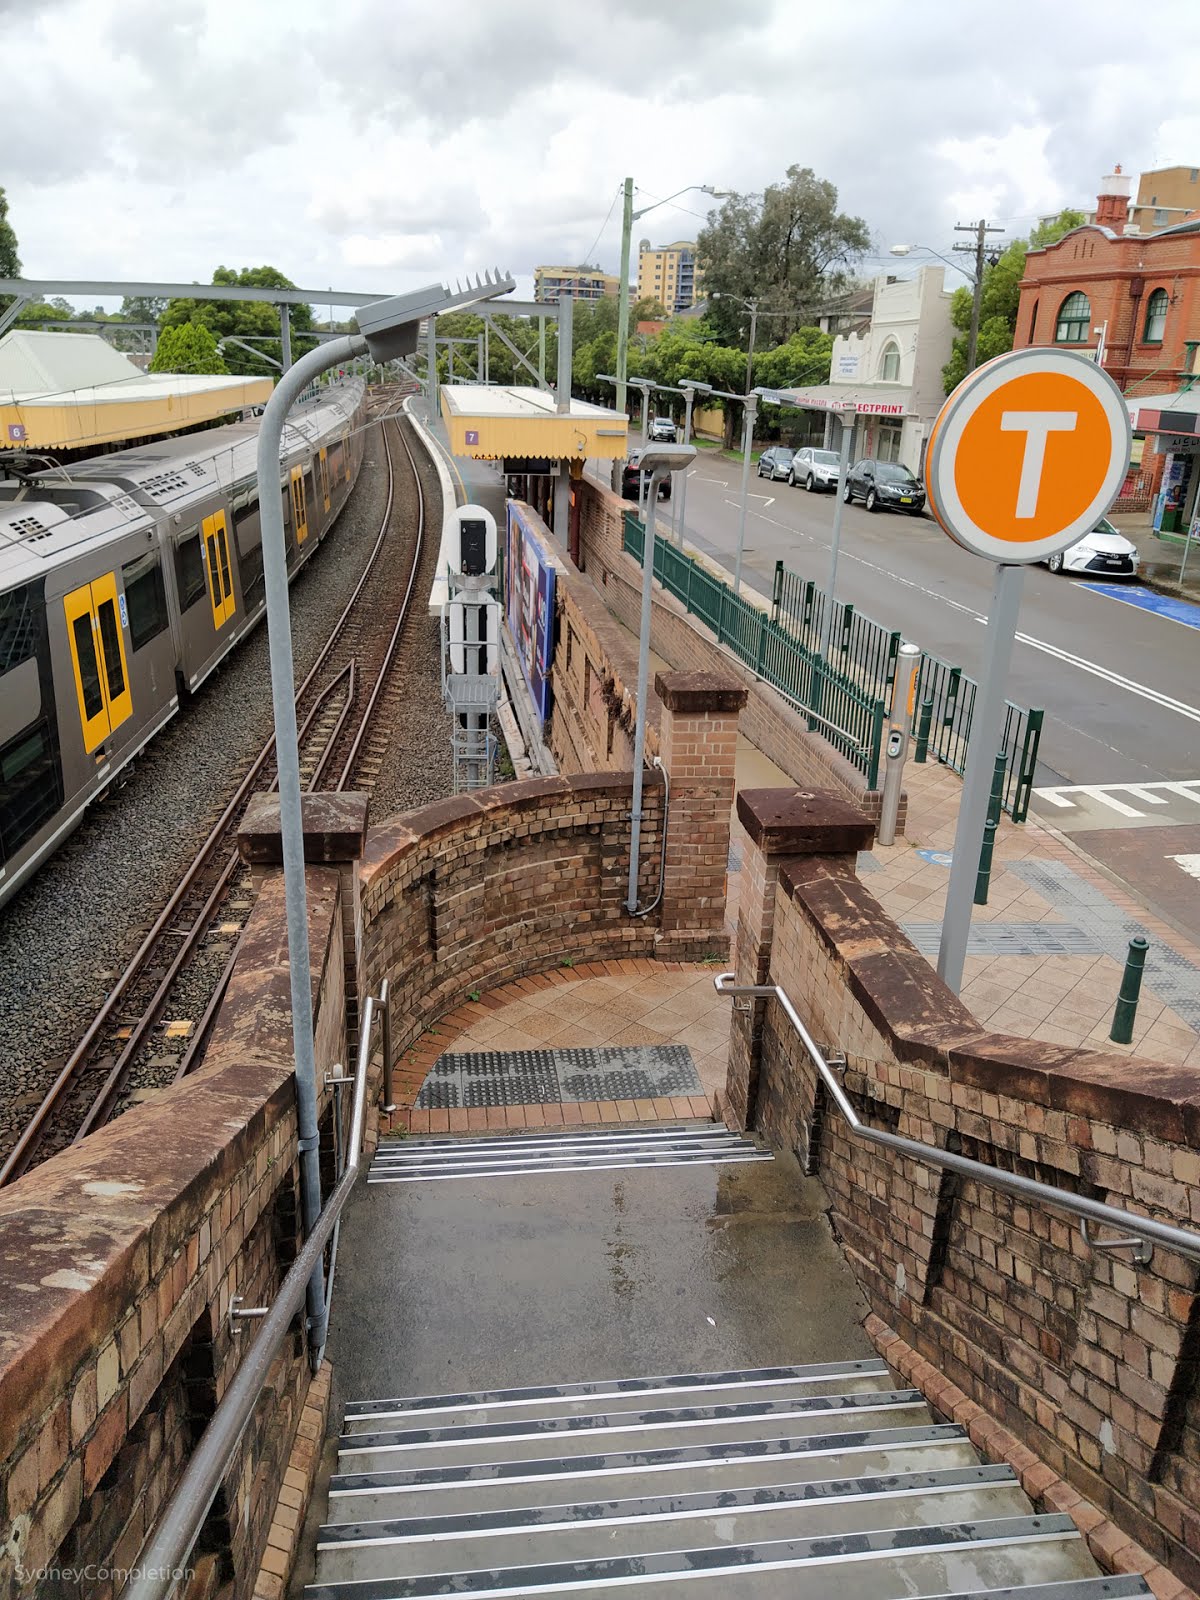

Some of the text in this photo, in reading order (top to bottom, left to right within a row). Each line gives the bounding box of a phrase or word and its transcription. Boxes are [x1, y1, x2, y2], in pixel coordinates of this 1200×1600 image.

[842, 403, 903, 413] ECTPRINT
[13, 427, 20, 437] 6
[469, 433, 475, 442] 7
[1000, 411, 1078, 518] T
